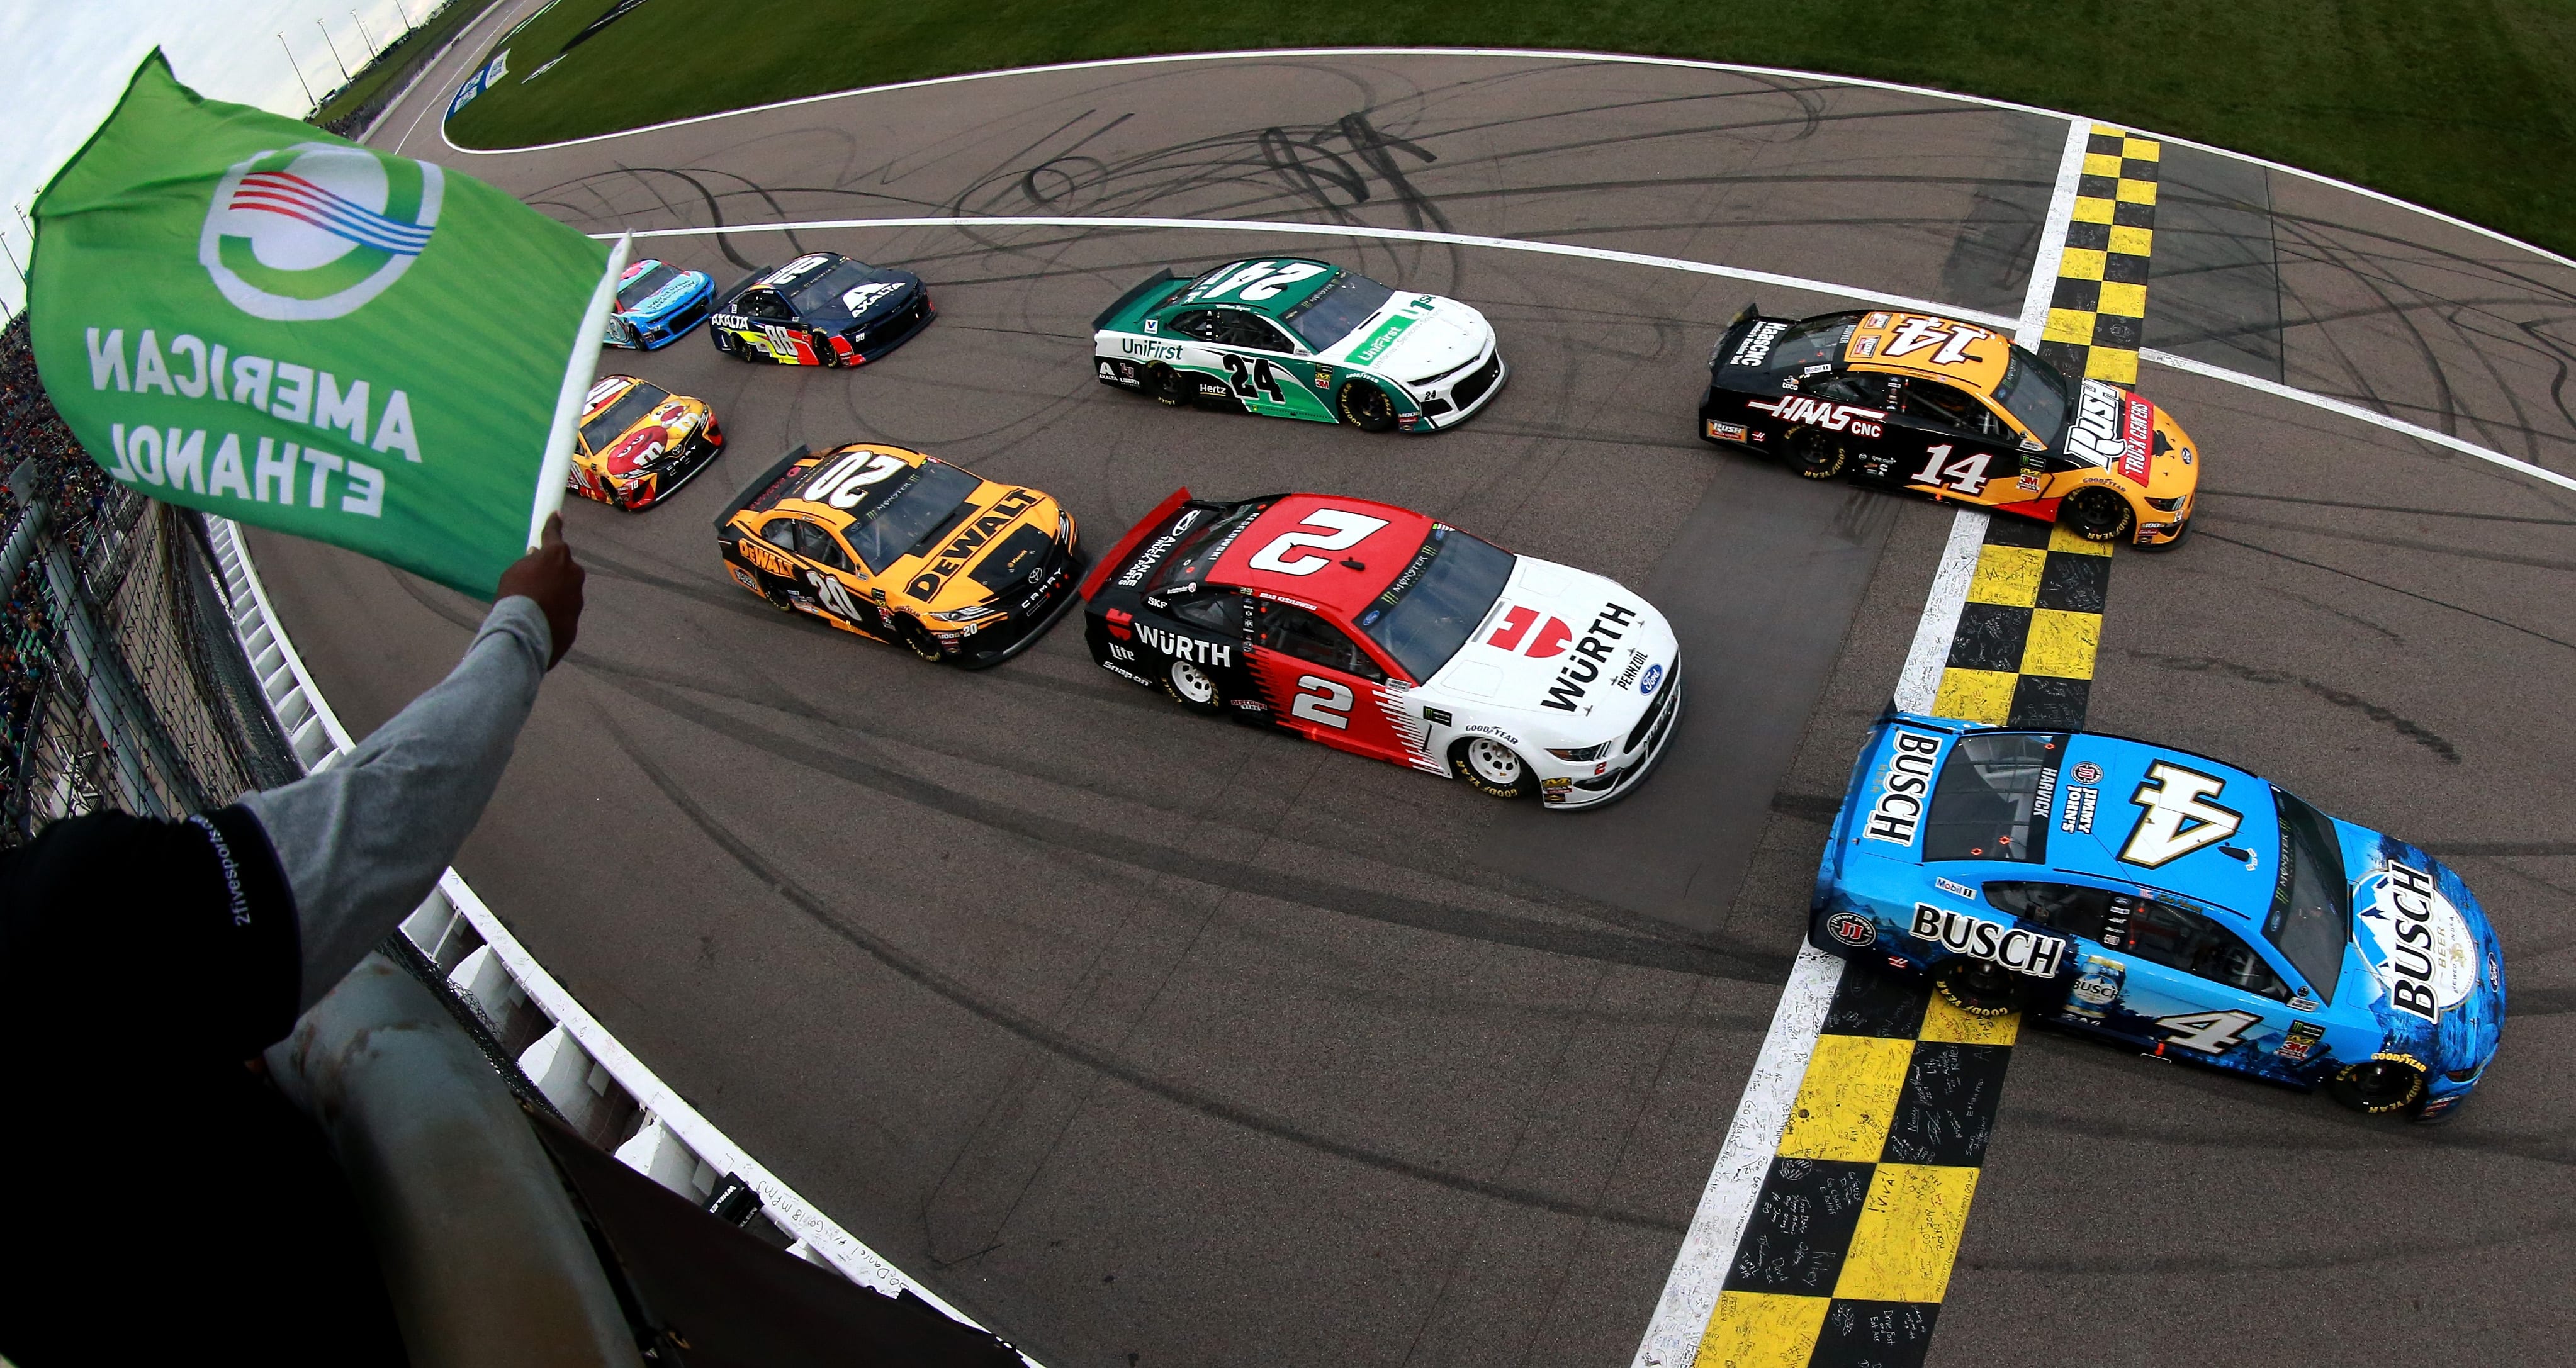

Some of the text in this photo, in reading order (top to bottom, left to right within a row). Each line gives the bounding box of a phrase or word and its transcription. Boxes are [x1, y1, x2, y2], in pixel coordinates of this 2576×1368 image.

[851, 282, 906, 318] AXALTA
[1201, 261, 1328, 301] 24
[711, 313, 749, 330] AXALTA
[765, 325, 799, 356] 88
[1122, 338, 1184, 360] UniFirst
[1881, 317, 1988, 366] 14
[1200, 384, 1227, 394] Hertz
[1222, 354, 1286, 405] 24
[1315, 379, 1330, 390] 3M
[1424, 390, 1437, 401] 24
[1748, 395, 1886, 430] HAAS
[1851, 421, 1881, 437] CNC
[2125, 400, 2149, 474] TRUCK CENTERS
[629, 479, 639, 490] 18
[802, 450, 910, 510] 20
[1910, 444, 1993, 494] 14
[2020, 475, 2039, 486] 3M
[1208, 512, 1260, 561] KESELOWSKI
[1248, 507, 1391, 576] 2
[1118, 535, 1169, 586] TRUCK PARTS
[1124, 535, 1176, 587] ALLIANCE
[1393, 554, 1428, 593] MONSTER
[806, 570, 863, 622] 20
[1021, 567, 1062, 609] CAMRY
[1147, 597, 1168, 609] SKF
[963, 623, 978, 637] 20
[1108, 642, 1135, 661] Lite
[1617, 651, 1648, 691] PENNZOIL
[1641, 668, 1661, 691] Ford
[1291, 675, 1354, 729] 2
[1465, 724, 1519, 746] GOODYEAR
[1456, 759, 1518, 798] GOODYEAR
[1594, 761, 1607, 775] 2
[1864, 730, 1942, 847] BUSCH
[2033, 766, 2058, 818] HARVICK
[2061, 784, 2083, 834] JOHN'S
[2078, 787, 2099, 835] JIMMY
[2116, 758, 2244, 870] 4
[1937, 878, 1962, 894] Mobil
[1910, 901, 2066, 978] BUSCH
[2388, 858, 2439, 1025] BUSCH
[2436, 926, 2447, 969] BEER
[1935, 979, 2008, 1017] GOODYEAR
[2072, 979, 2119, 999] BUSCH
[2154, 1008, 2265, 1056] 4
[2283, 1041, 2309, 1053] 3M
[2370, 1053, 2427, 1073] GOODYEAR
